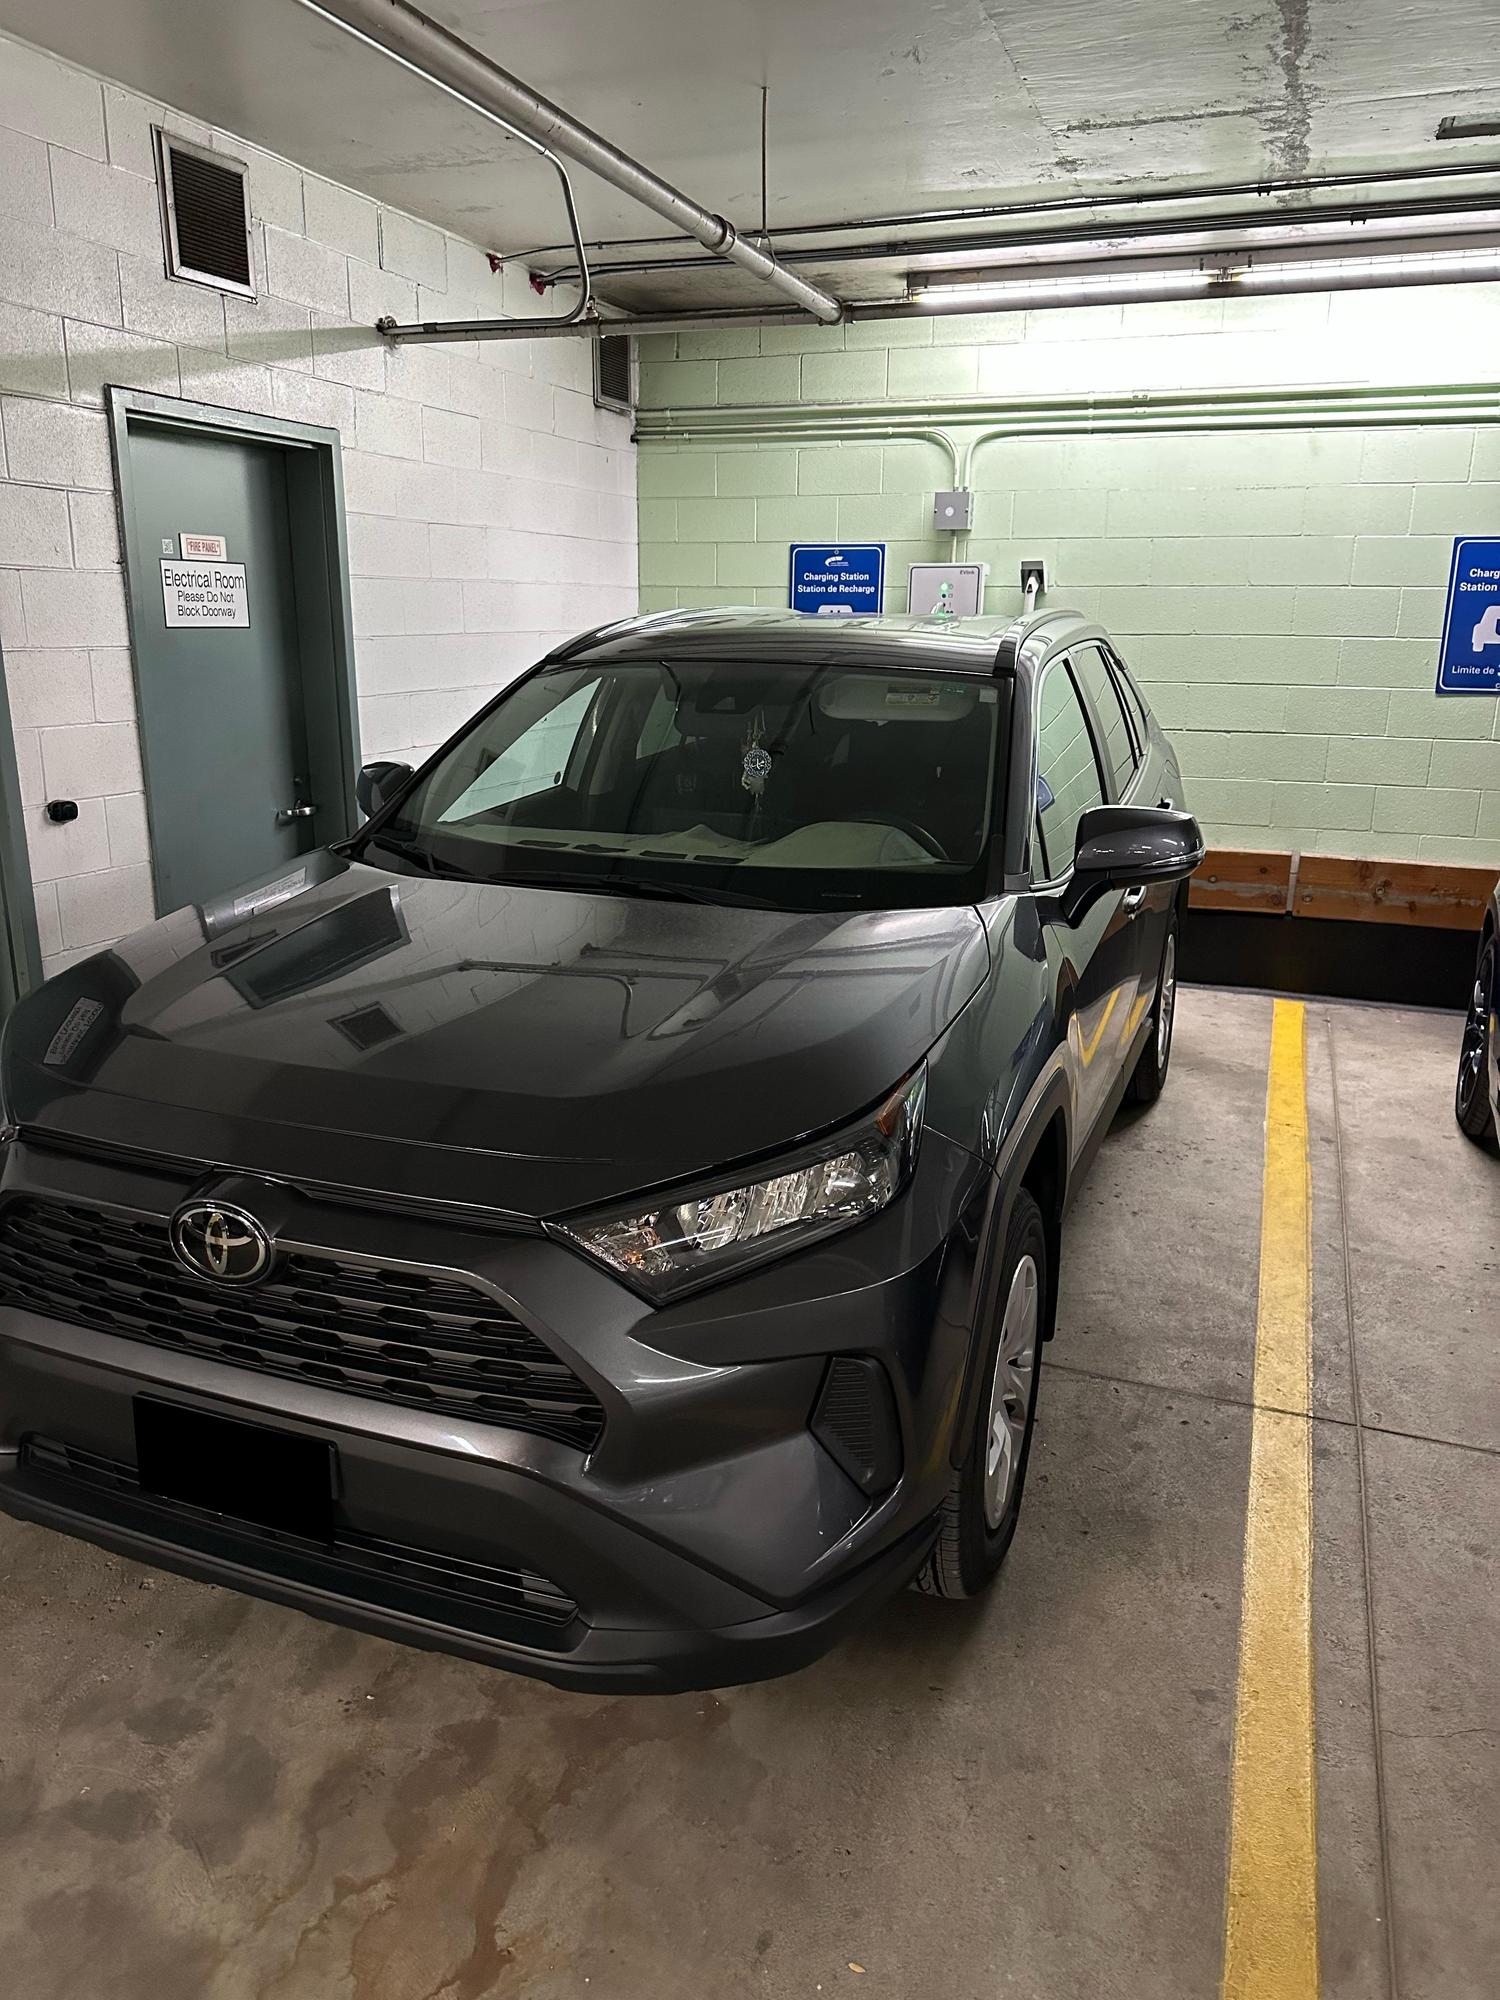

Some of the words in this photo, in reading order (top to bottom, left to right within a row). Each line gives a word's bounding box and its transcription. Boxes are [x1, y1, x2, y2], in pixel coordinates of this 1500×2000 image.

[164, 568, 212, 588] Electrical
[214, 571, 245, 589] Room
[803, 572, 839, 582] Charging
[840, 572, 869, 581] Station
[797, 584, 826, 593] Station
[827, 584, 838, 593] de
[839, 584, 875, 595] Recharge
[1459, 582, 1498, 591] Station
[177, 590, 205, 602] Please
[206, 591, 219, 603] Do
[220, 591, 234, 603] Not
[177, 604, 201, 617] Block
[202, 605, 236, 619] Doorway
[1451, 665, 1481, 675] Limite
[1482, 666, 1495, 675] de
